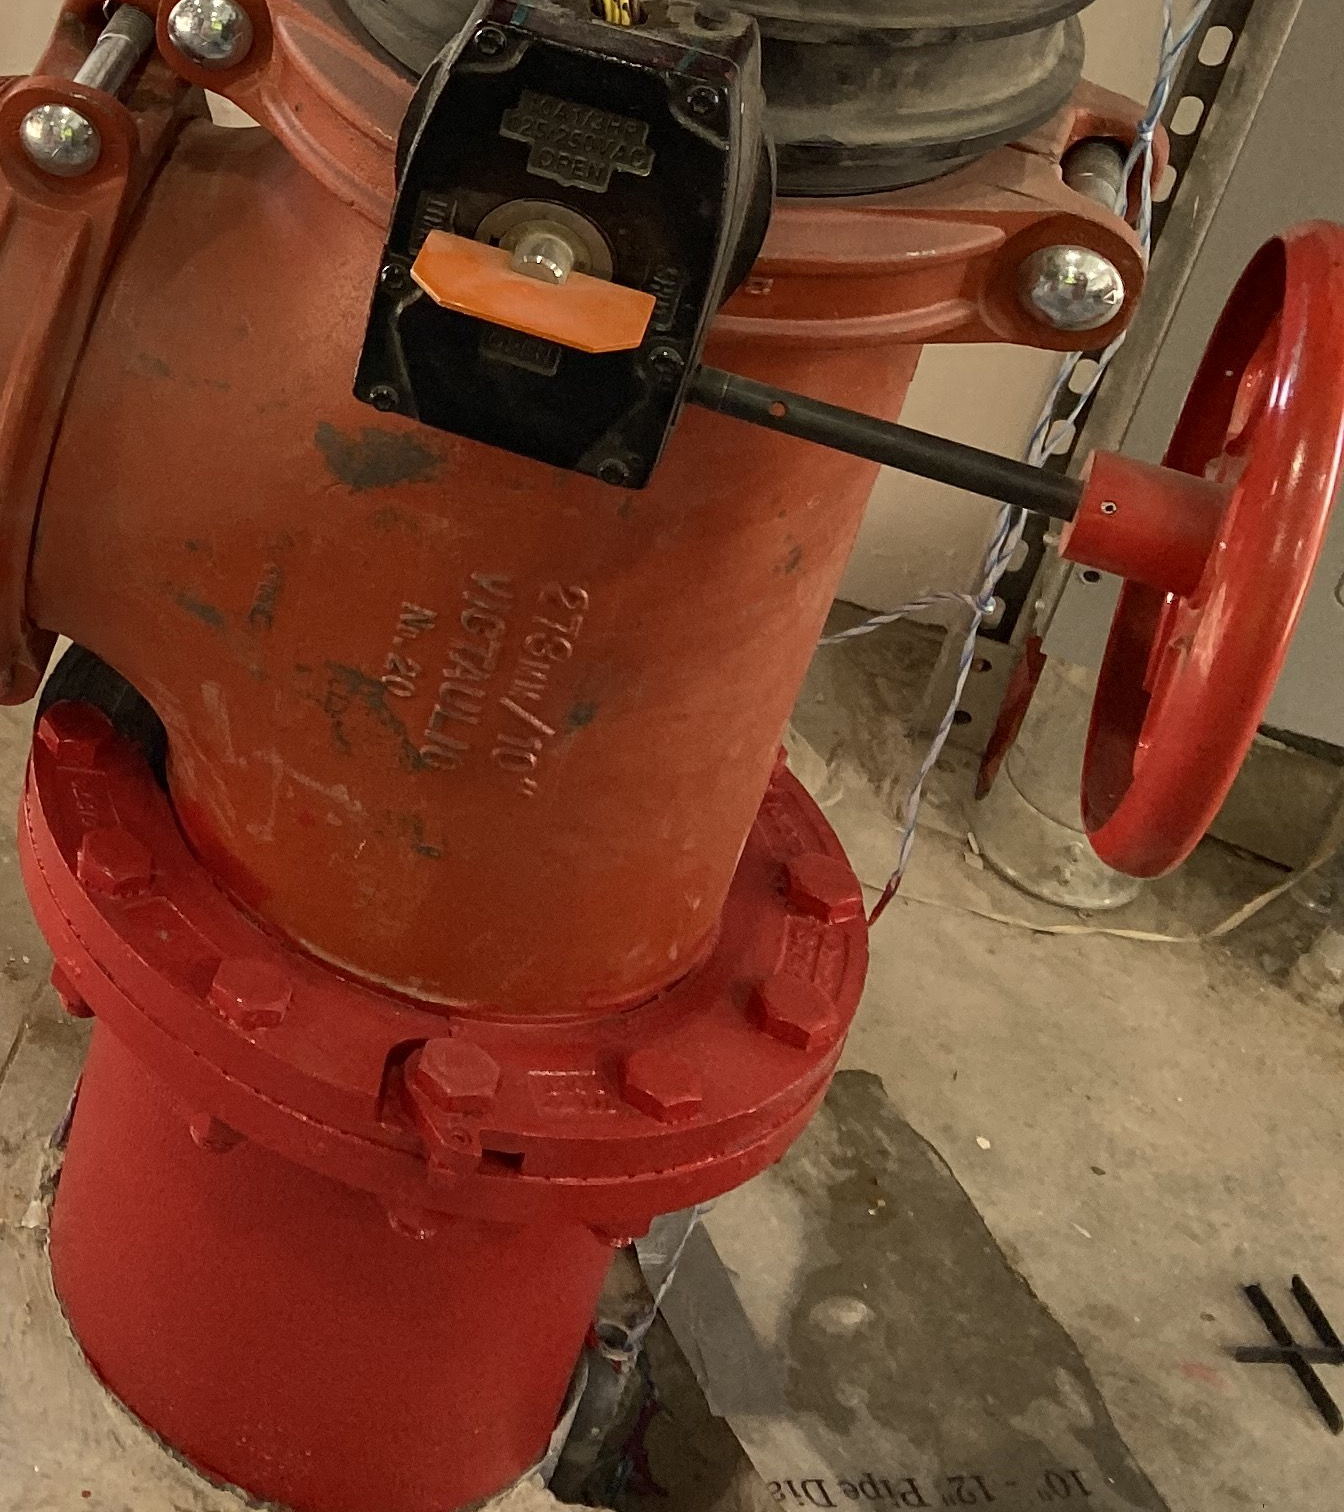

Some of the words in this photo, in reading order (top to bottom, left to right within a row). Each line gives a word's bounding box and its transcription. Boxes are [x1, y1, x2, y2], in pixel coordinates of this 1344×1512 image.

[539, 148, 607, 180] OPEN
[381, 651, 422, 698] 20
[419, 571, 513, 770] VICTAULIC
[837, 1472, 932, 1508] Pipe
[941, 1474, 996, 1506] 12"
[1036, 1468, 1093, 1502] 10"
